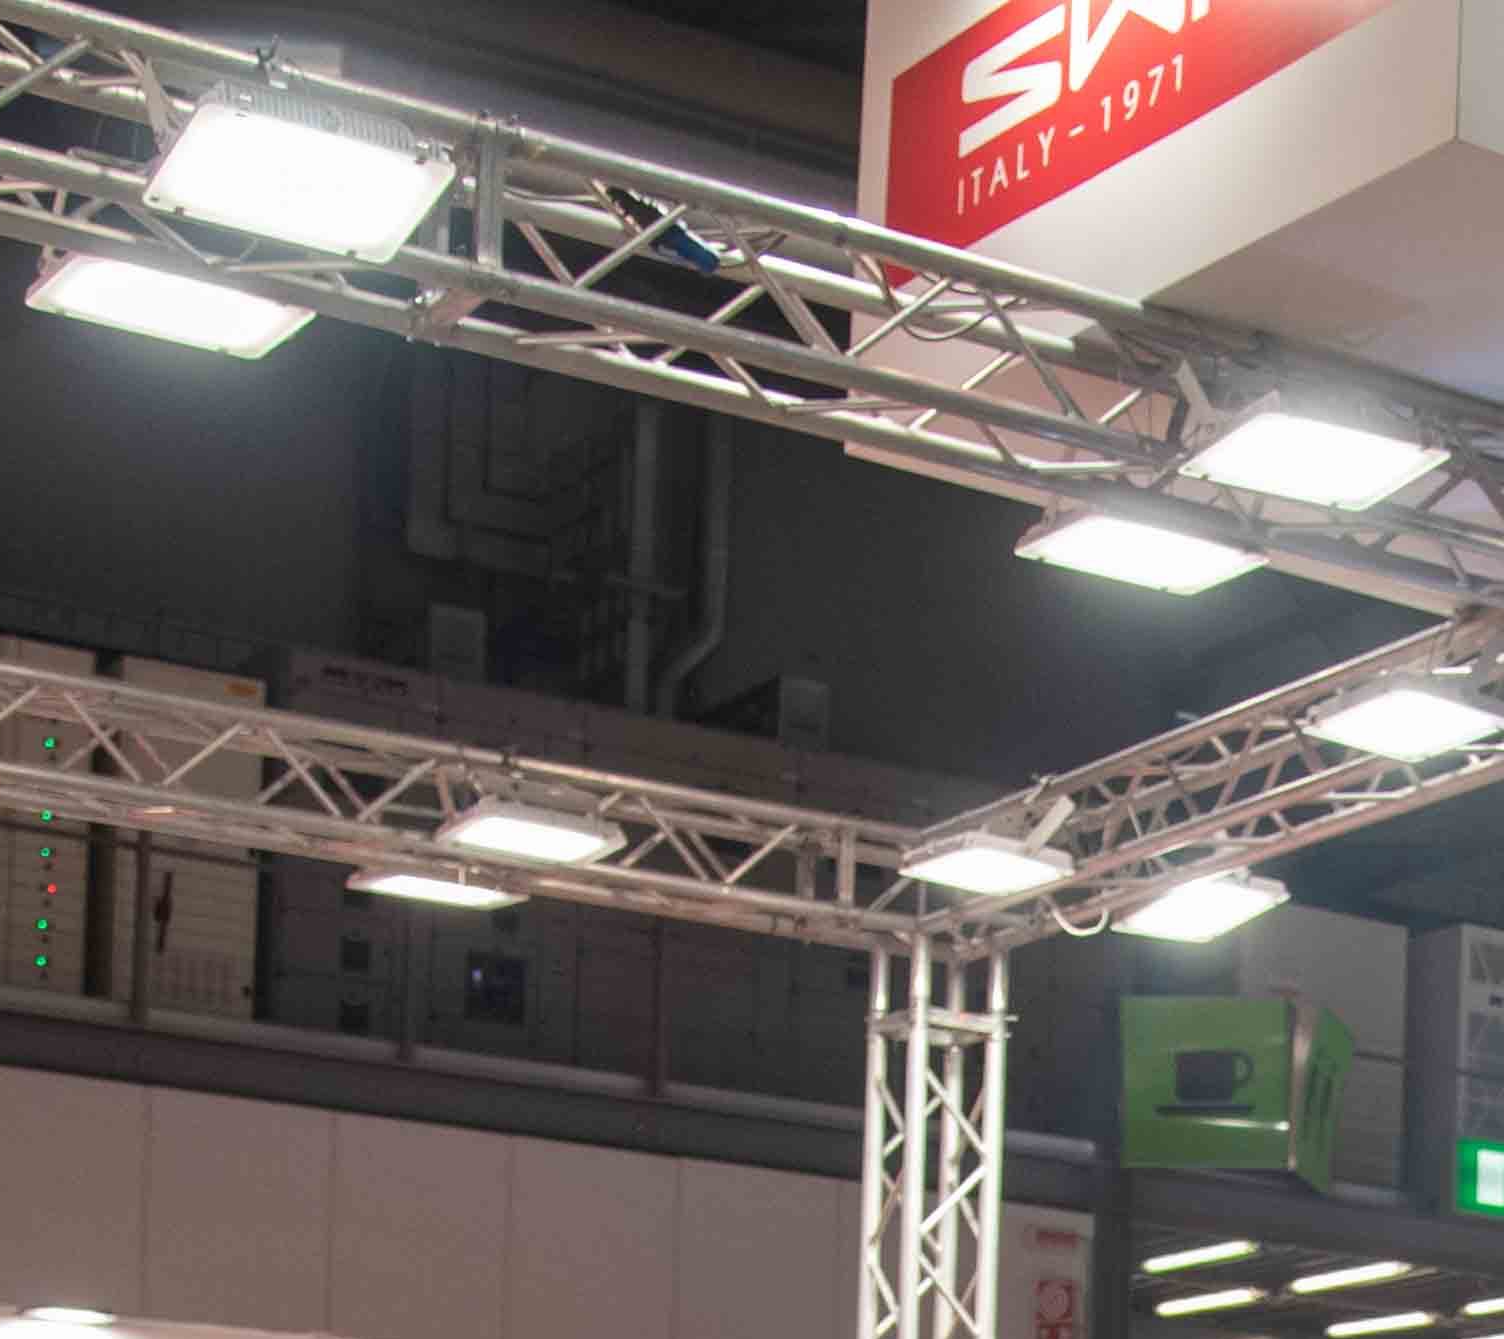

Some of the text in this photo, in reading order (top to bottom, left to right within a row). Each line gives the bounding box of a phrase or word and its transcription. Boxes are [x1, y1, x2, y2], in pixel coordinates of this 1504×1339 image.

[957, 126, 1056, 216] ITALY
[1100, 53, 1186, 132] 1971
[958, 0, 1211, 158] SW
